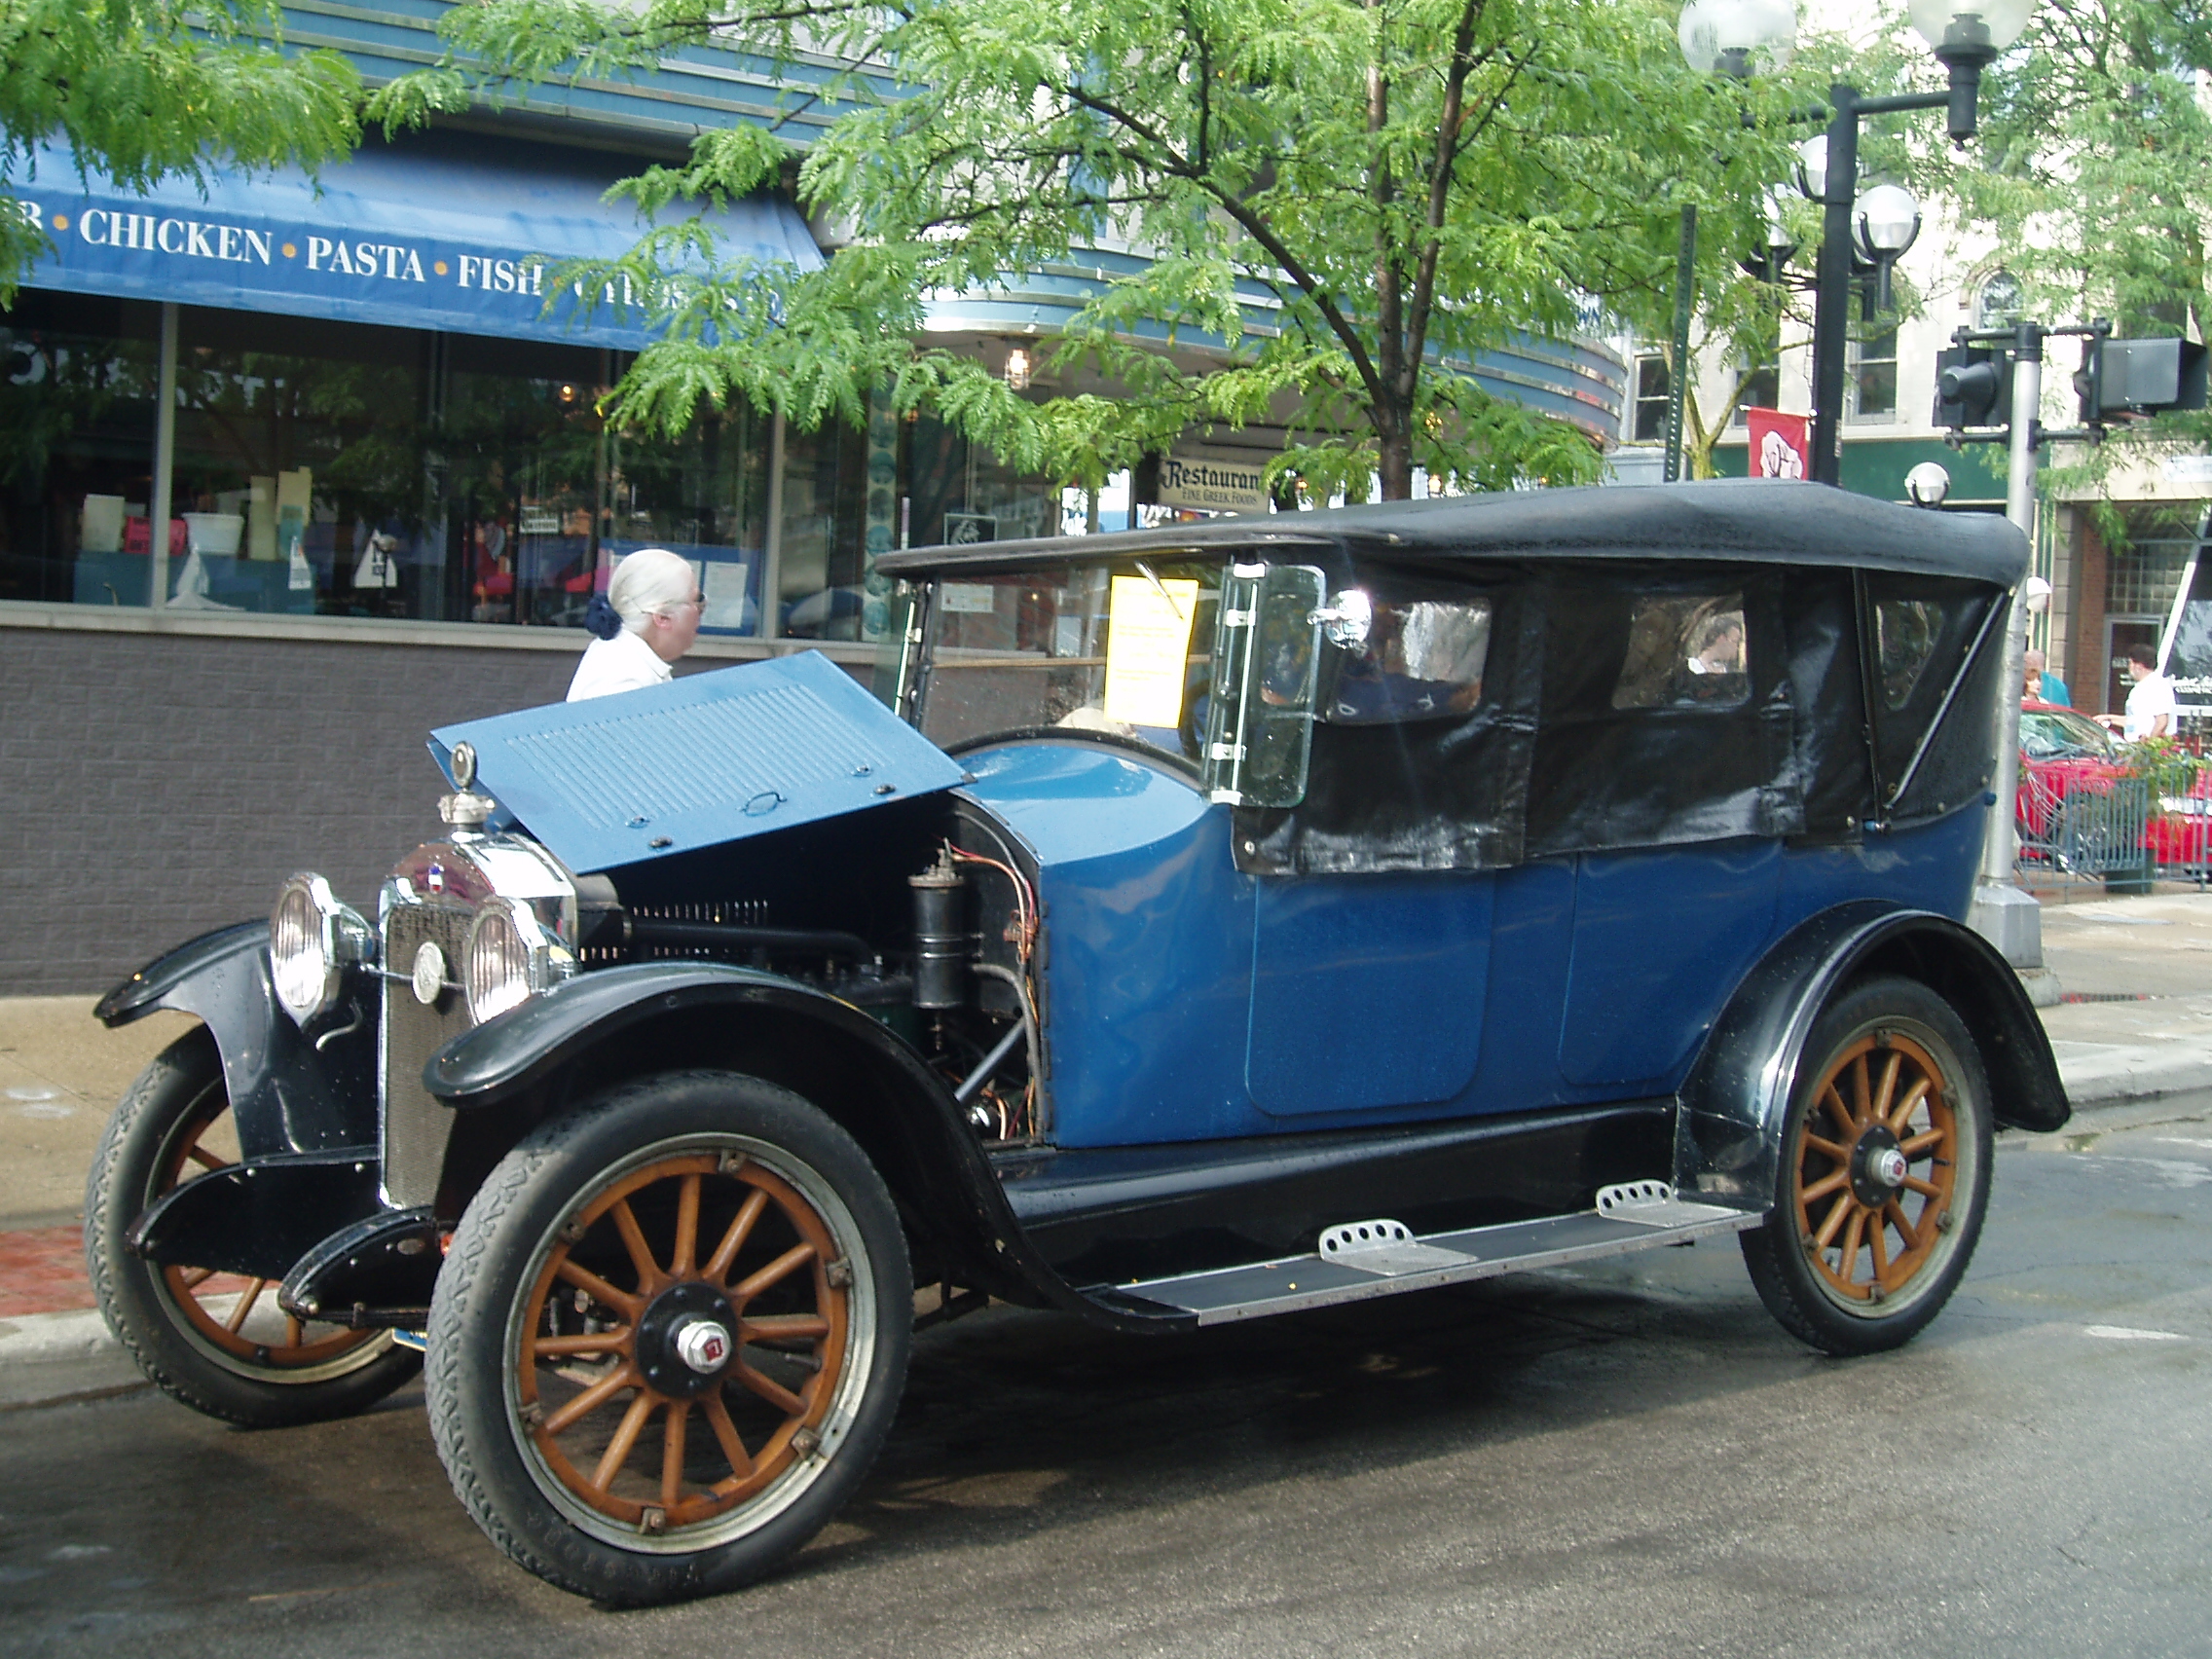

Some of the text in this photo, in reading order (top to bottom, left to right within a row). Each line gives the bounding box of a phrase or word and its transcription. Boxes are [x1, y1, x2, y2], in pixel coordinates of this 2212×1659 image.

[79, 208, 274, 266] CHICKEN
[306, 236, 425, 282] PASTA
[457, 254, 544, 296] FISH
[1161, 461, 1260, 491] Restauran
[1182, 489, 1200, 500] FINE
